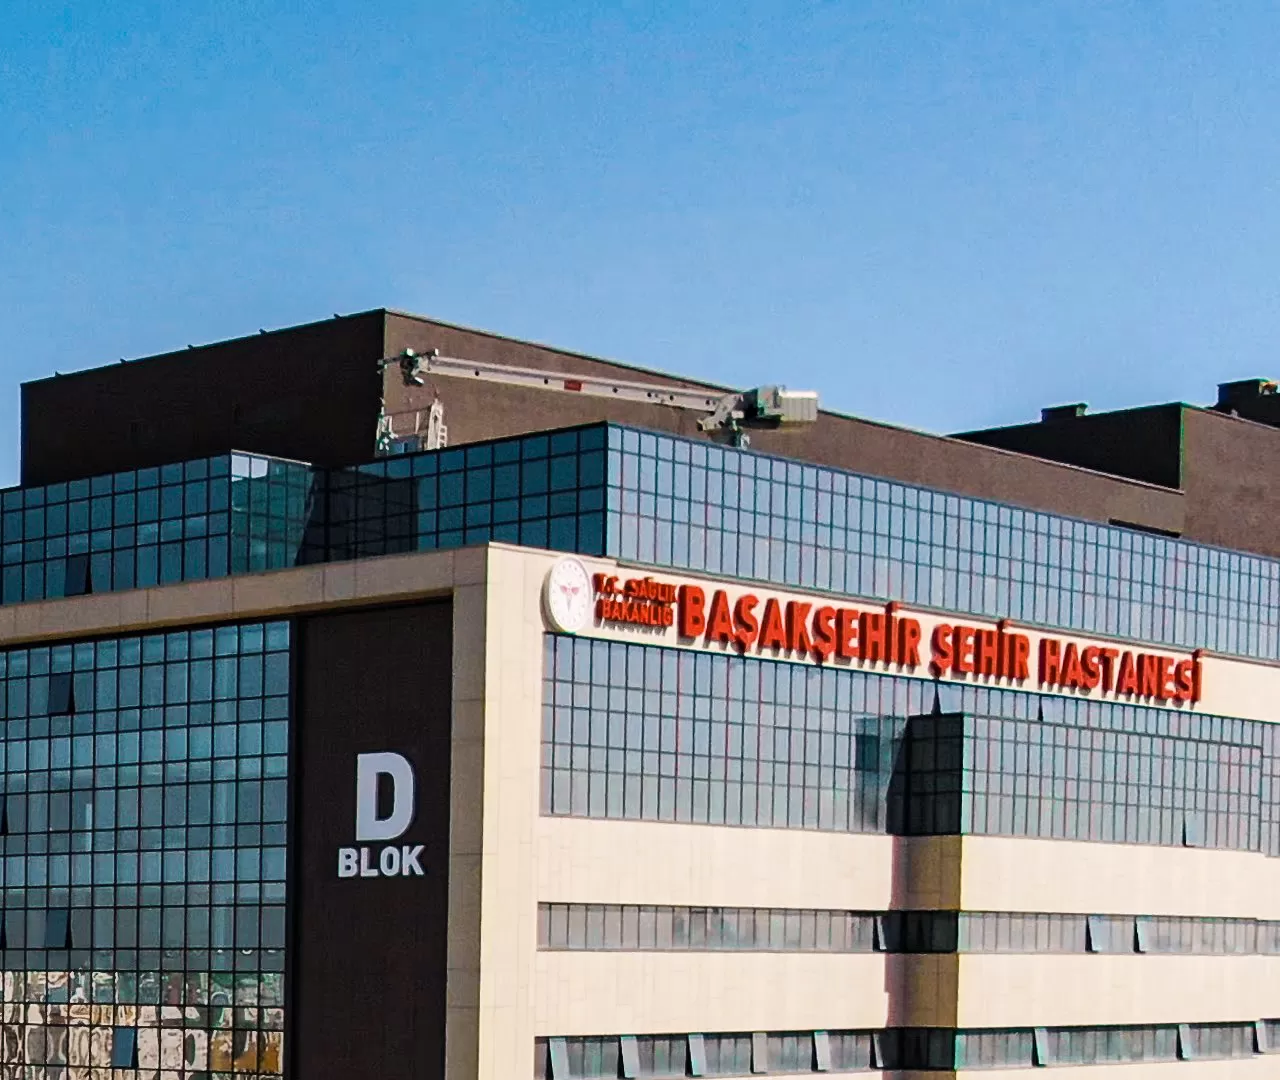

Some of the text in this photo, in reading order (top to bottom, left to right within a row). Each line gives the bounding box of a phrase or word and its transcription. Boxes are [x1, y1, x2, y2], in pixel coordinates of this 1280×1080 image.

[624, 576, 679, 603] SAĞLIK
[595, 600, 674, 627] BAKANLIĞ
[678, 584, 1202, 703] BAŞAKŞEHİR ŞEHİR HASTANESİ
[356, 751, 414, 841] D
[338, 845, 425, 878] BLOK
